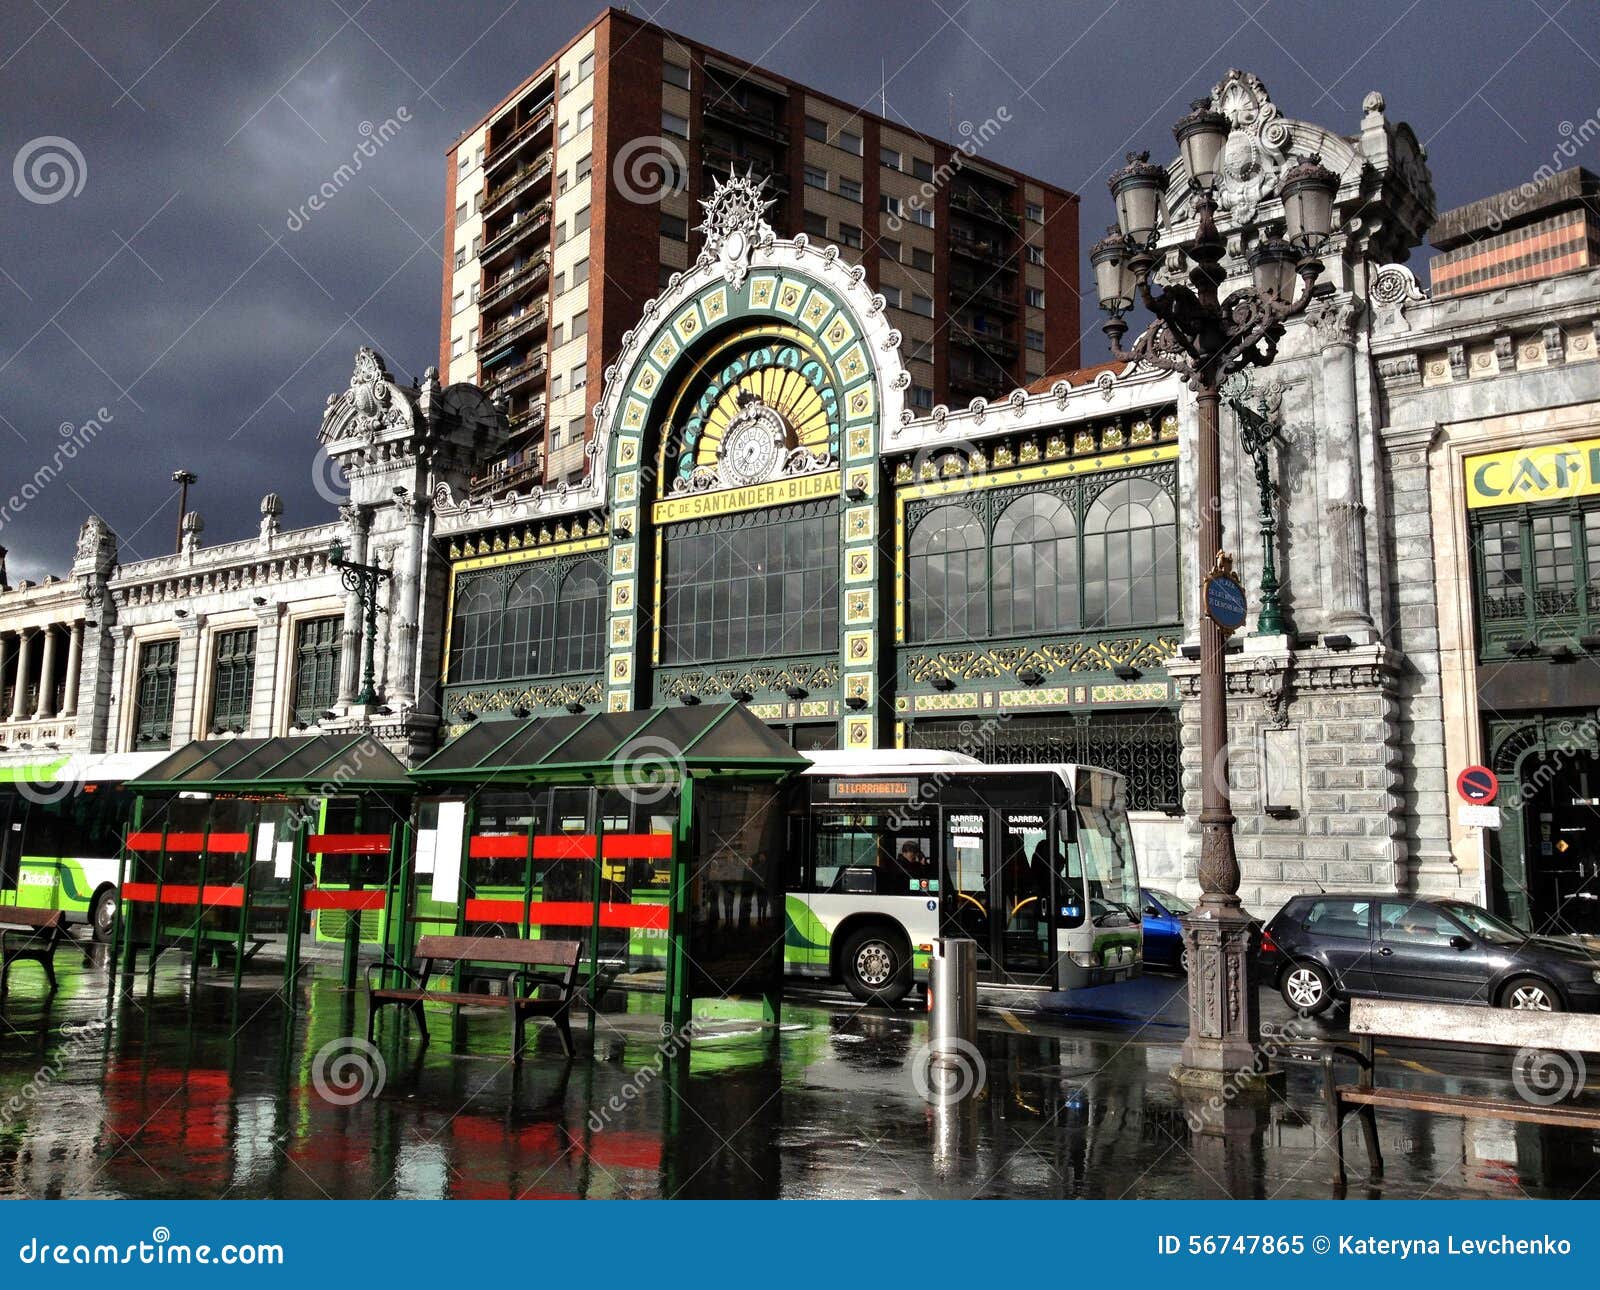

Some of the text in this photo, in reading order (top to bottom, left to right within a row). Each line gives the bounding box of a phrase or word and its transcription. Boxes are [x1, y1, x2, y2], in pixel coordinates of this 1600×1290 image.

[679, 503, 690, 513] DE
[694, 487, 774, 513] SANTANDER
[779, 488, 784, 497] A
[1008, 815, 1044, 823] SARRERA
